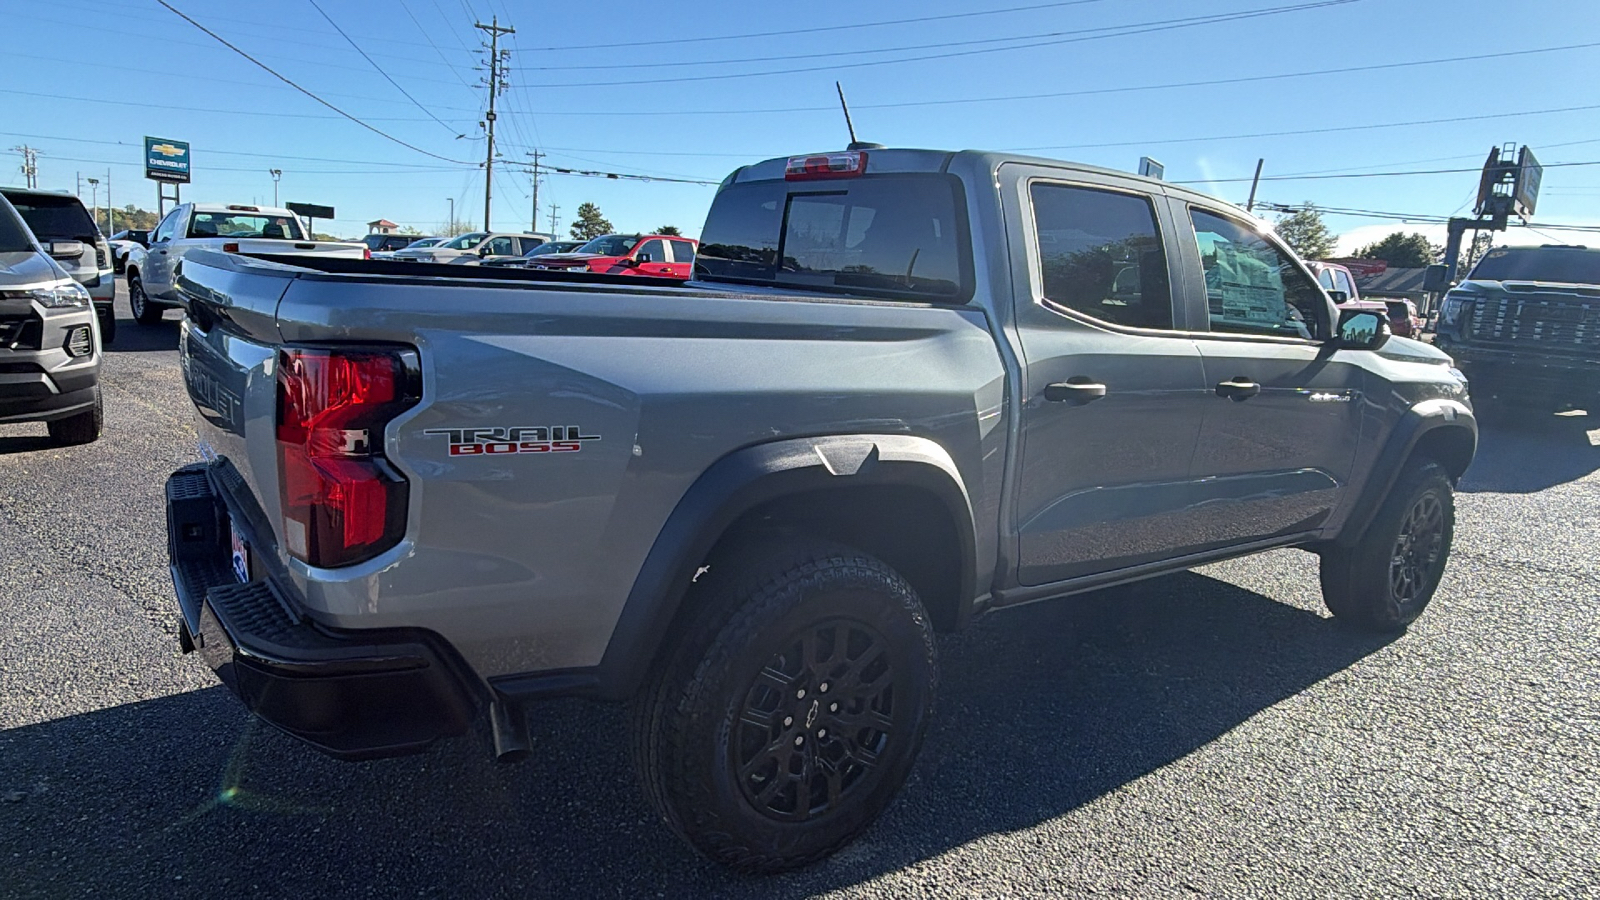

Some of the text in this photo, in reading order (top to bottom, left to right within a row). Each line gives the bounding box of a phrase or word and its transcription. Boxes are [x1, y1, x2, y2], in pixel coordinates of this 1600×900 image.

[149, 158, 187, 169] CHEVROLET
[184, 358, 242, 426] ROLET
[423, 425, 602, 444] TRAIL
[449, 440, 581, 457] BOSS
